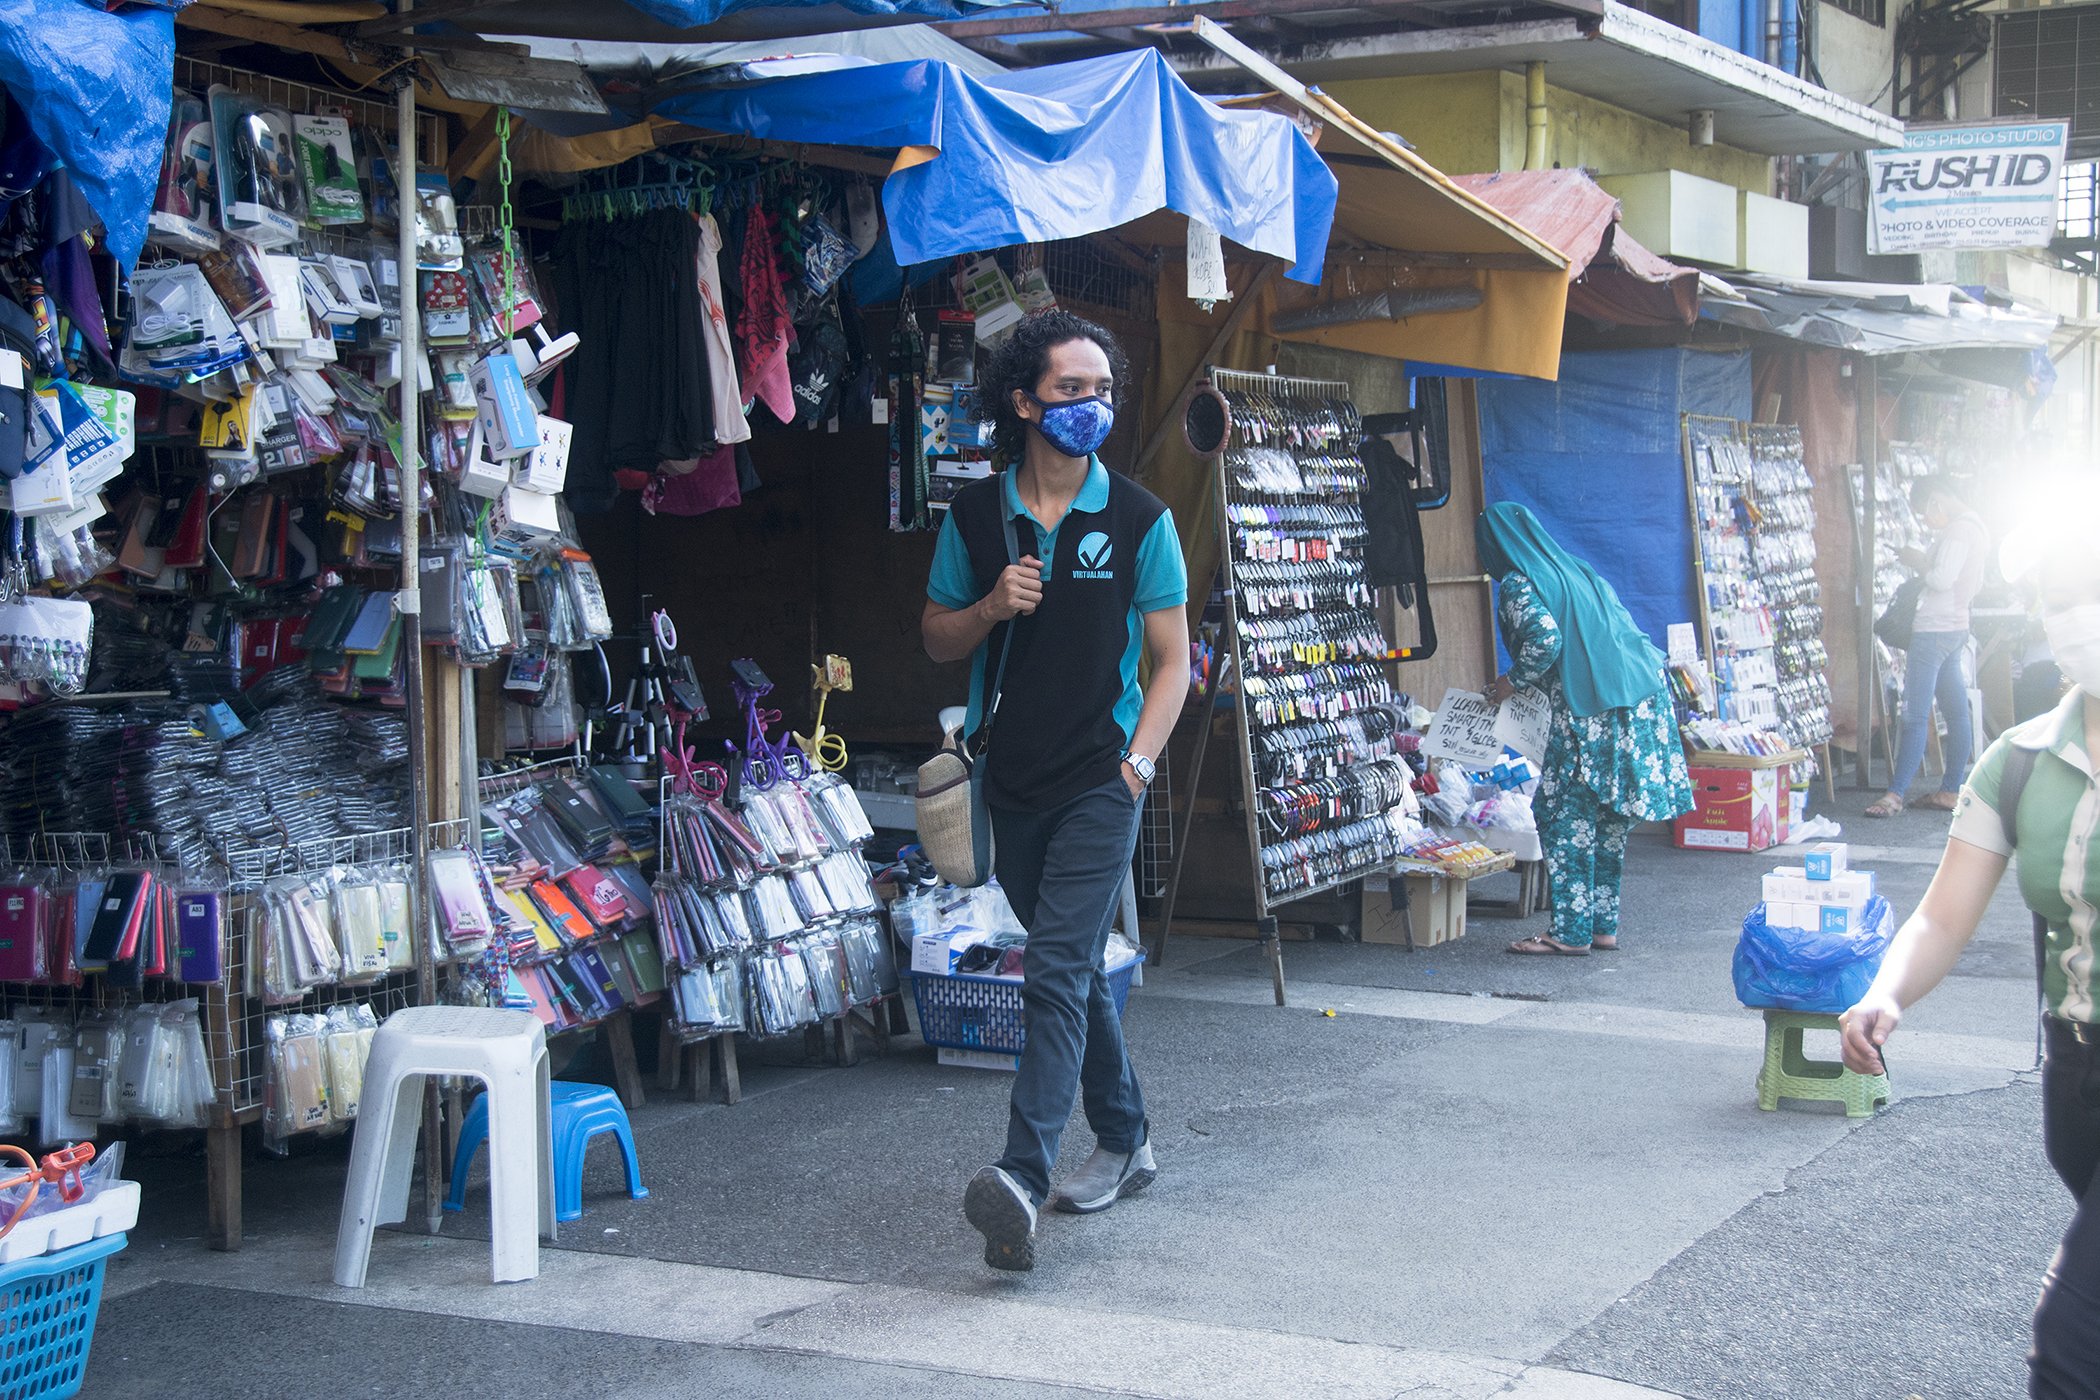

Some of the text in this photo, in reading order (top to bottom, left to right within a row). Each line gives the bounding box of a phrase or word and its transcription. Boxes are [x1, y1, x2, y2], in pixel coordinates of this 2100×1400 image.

[1903, 128, 2056, 149] NG'S PHOTO STUDIO
[1874, 153, 2052, 194] RUSH ID
[1953, 189, 1982, 198] Minutes
[1935, 206, 1992, 217] WE ACCEPT
[1925, 219, 1934, 231] &
[1935, 218, 1976, 229] VIDEO
[1978, 215, 2049, 227] COVERAGE
[1924, 230, 1958, 239] BIRTHDAY
[794, 384, 822, 406] adidas
[1072, 570, 1113, 579] VIRTUALAHAN
[1510, 708, 1526, 724] TNT
[1511, 696, 1539, 721] SMART
[1439, 724, 1461, 737] TNT
